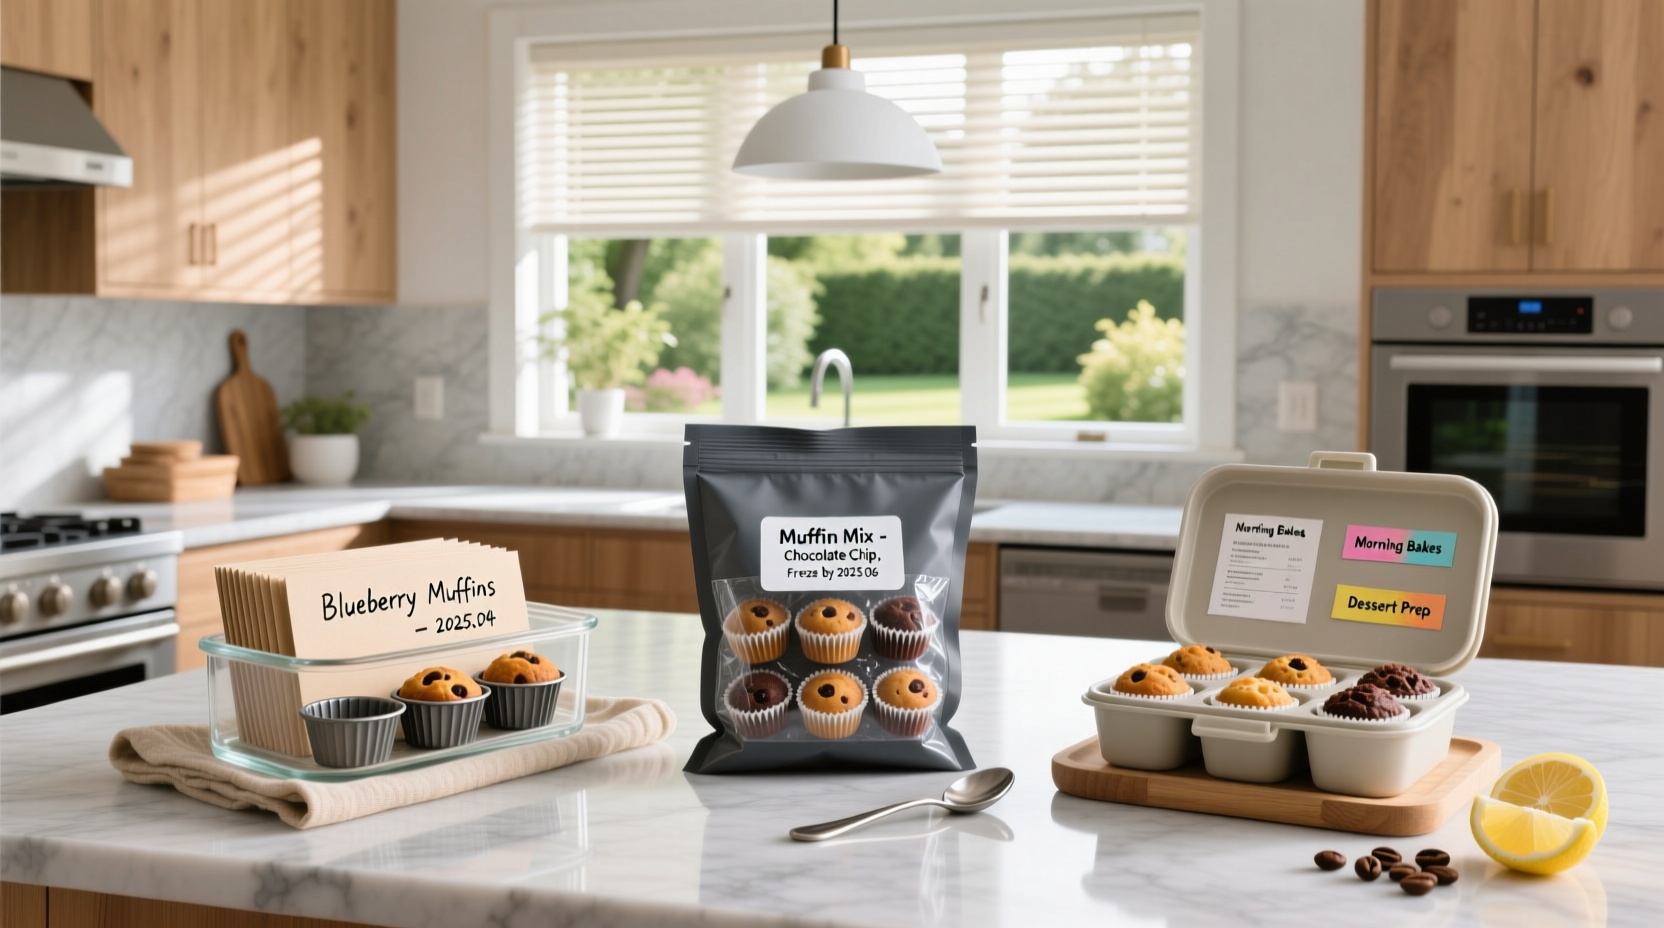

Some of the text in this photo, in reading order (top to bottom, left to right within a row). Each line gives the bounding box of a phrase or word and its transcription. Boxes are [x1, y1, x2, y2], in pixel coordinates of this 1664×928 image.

[780, 527, 838, 544] Muffin
[843, 527, 873, 544] Mix
[1354, 536, 1442, 554] Morning Bakes
[784, 548, 881, 563] Chocolate Chip,
[822, 566, 834, 581] by
[322, 576, 496, 621] Blueberry Muffins
[1347, 595, 1431, 620] Dessert Prep
[435, 609, 496, 634] 2025.04
